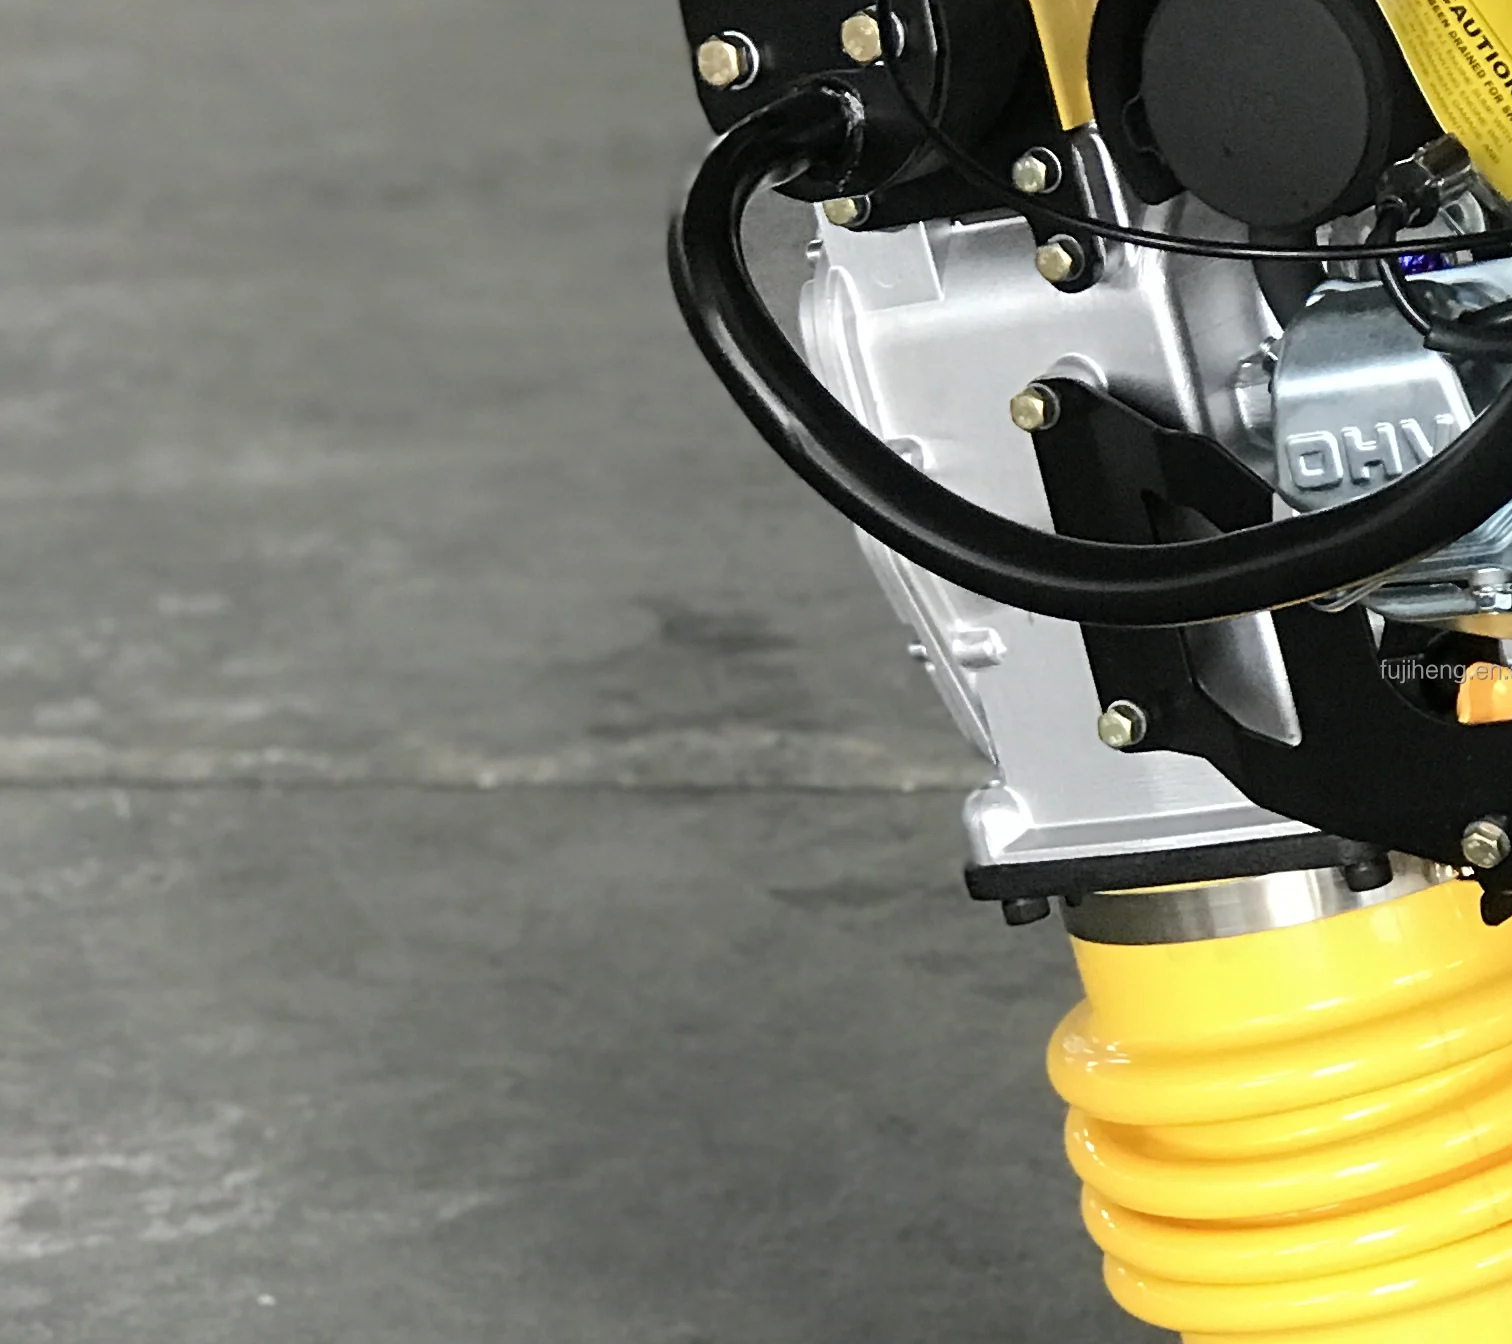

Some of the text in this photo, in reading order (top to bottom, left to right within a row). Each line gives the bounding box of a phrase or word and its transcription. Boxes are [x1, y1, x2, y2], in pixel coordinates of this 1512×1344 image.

[1449, 30, 1485, 79] DRAINED
[1485, 80, 1503, 103] FOR
[1287, 413, 1454, 489] OHV
